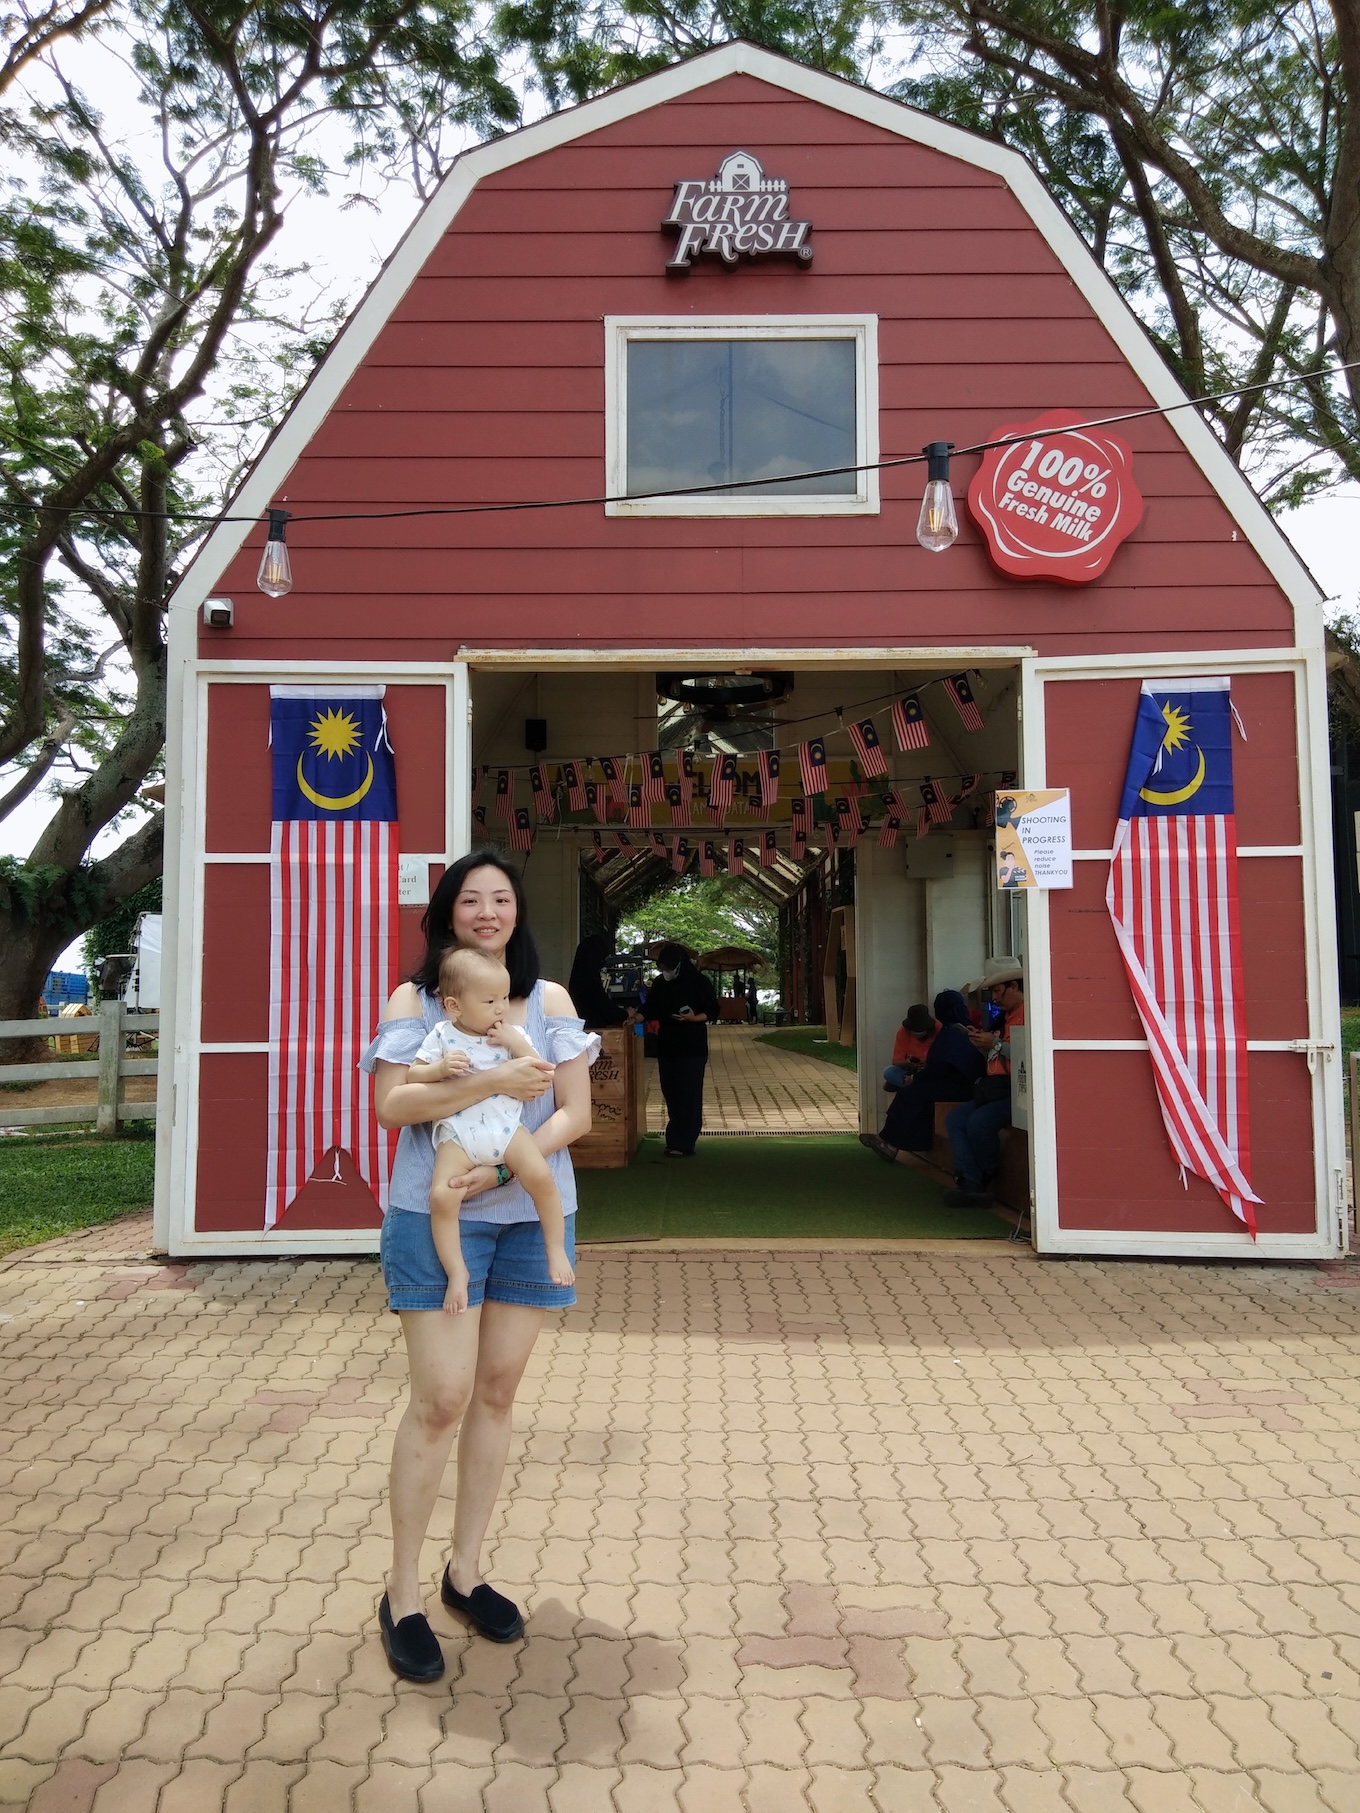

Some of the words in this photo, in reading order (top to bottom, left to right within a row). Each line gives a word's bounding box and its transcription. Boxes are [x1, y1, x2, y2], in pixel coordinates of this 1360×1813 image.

[1020, 440, 1112, 499] 100%
[998, 491, 1049, 525] Fresh
[1049, 512, 1094, 542] Milk
[1006, 469, 1102, 523] Genuine
[1021, 816, 1067, 825] SHOOTING
[1022, 836, 1066, 844] PROGRESS
